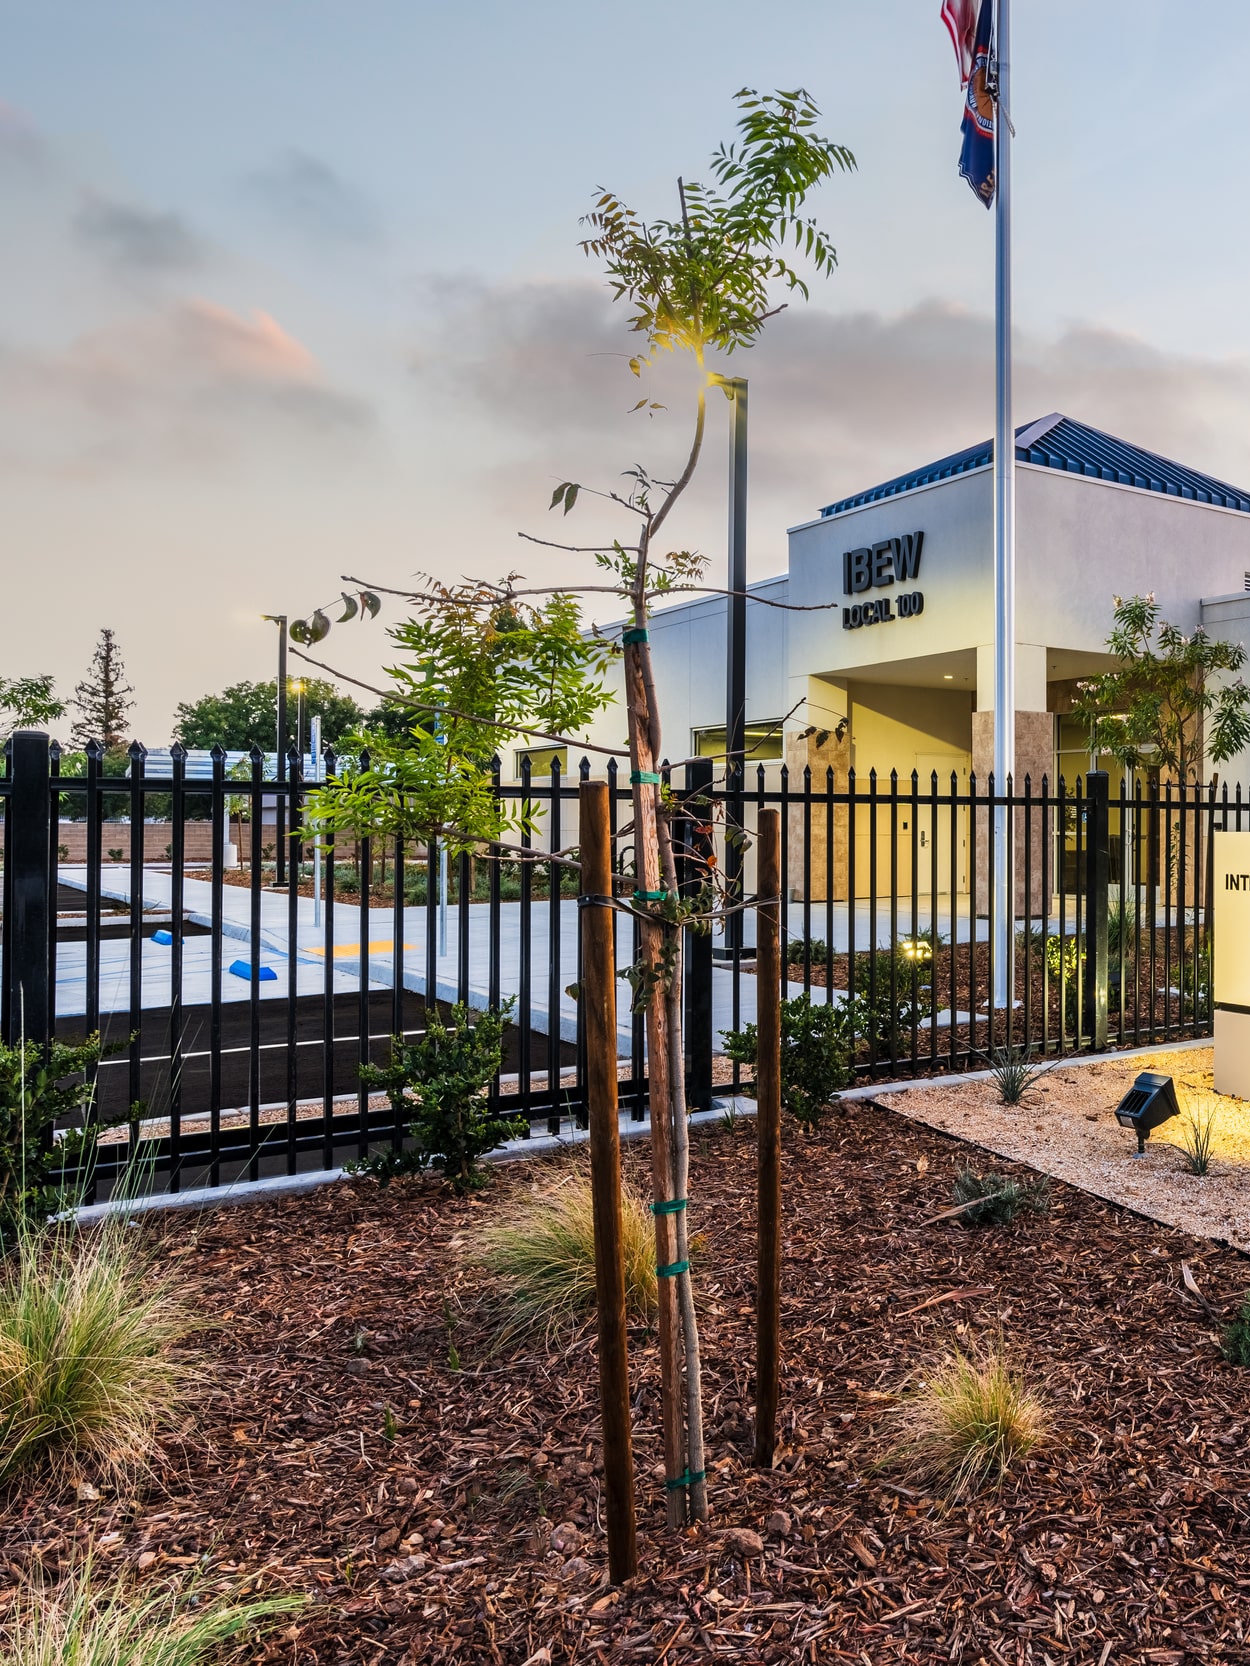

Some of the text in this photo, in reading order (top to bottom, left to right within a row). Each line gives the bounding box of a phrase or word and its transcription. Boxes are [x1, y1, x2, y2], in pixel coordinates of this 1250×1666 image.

[843, 531, 924, 594] IBEW
[843, 592, 924, 630] LOCAL 100
